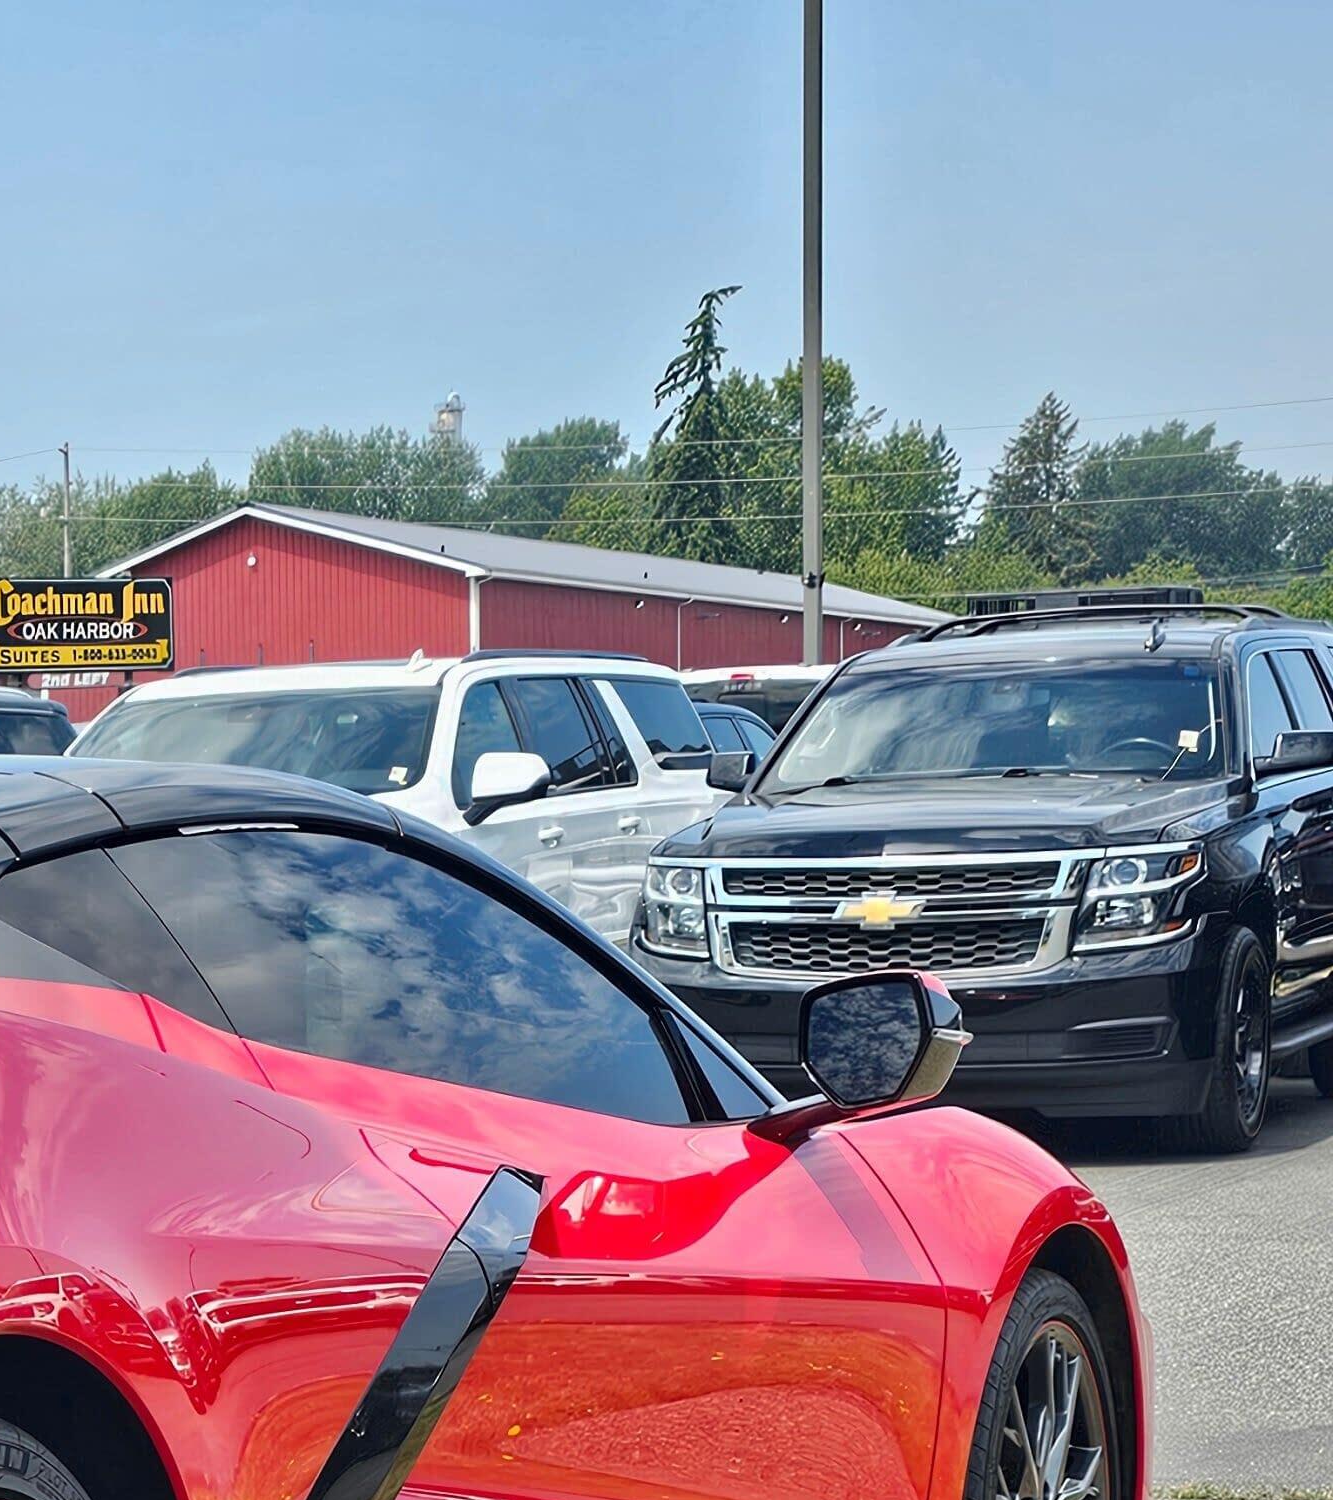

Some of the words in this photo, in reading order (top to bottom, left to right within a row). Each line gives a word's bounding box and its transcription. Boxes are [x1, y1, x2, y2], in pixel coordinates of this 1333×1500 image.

[121, 581, 165, 623] Inn
[23, 622, 59, 640] OAK
[63, 621, 134, 640] HARBOR
[0, 649, 60, 664] SUITES
